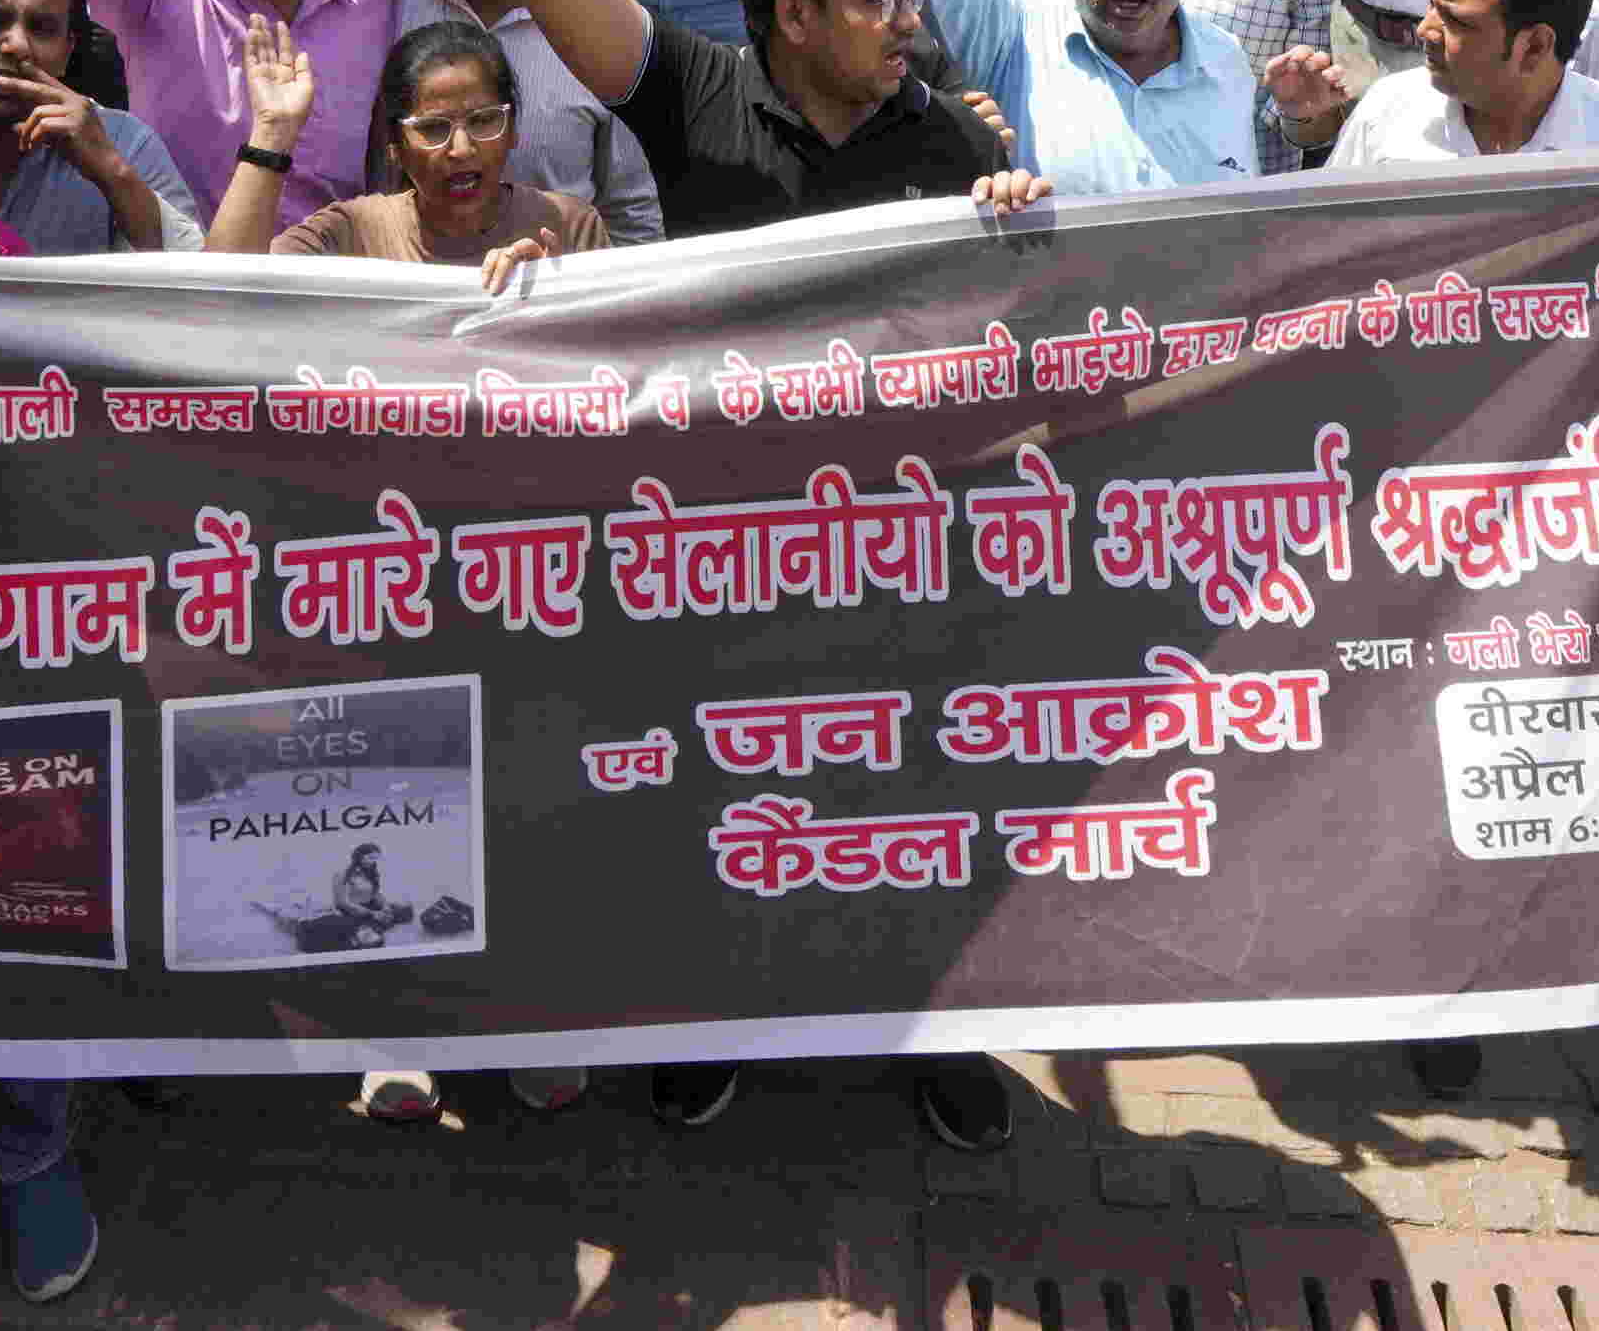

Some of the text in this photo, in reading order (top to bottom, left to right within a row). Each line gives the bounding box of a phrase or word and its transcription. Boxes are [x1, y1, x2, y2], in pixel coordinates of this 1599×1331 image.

[102, 384, 258, 435] समस्त
[475, 363, 629, 437] निवासी
[652, 371, 691, 430] व
[713, 349, 763, 426] के
[767, 338, 865, 421] सभी
[870, 320, 1020, 412] व्यापारी
[1029, 306, 1155, 395] भाईयो
[1159, 316, 1248, 378] द्वारा
[1357, 278, 1403, 348] के
[1404, 271, 1484, 348] प्रति
[1488, 281, 1591, 342] सख्त
[168, 505, 260, 655] में
[273, 488, 440, 647] मारे
[450, 515, 593, 638] गए
[604, 455, 955, 622] सेलानीयो
[966, 444, 1077, 598] को
[1336, 637, 1416, 671] स्थान
[1444, 614, 1521, 671] गली
[1526, 609, 1591, 666] भैरो
[298, 694, 345, 725] All
[580, 645, 1329, 791] एवं जन आक्रोश
[24, 753, 79, 773] ON
[276, 730, 370, 760] EYES
[290, 772, 354, 797] ON
[1460, 746, 1587, 802] अप्रैल
[207, 802, 435, 843] PAHALGAM
[994, 768, 1217, 881] मार्च
[1474, 817, 1554, 850] शाम
